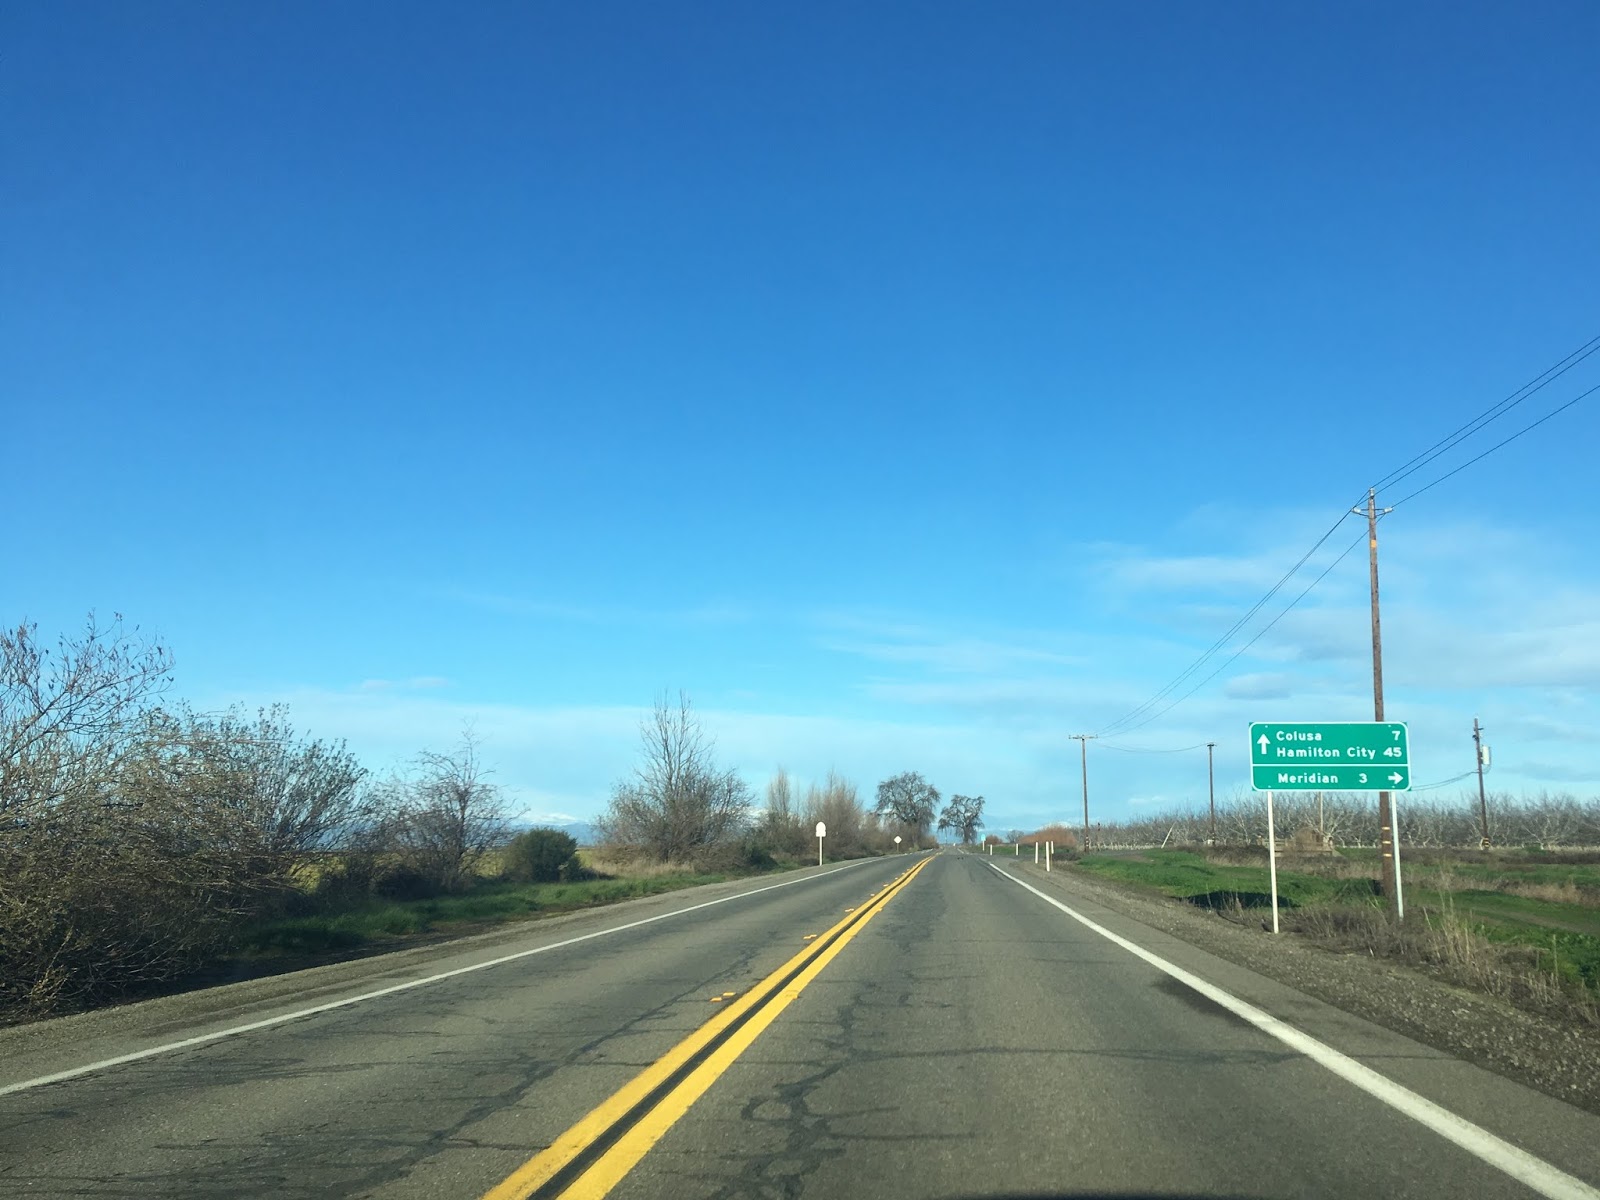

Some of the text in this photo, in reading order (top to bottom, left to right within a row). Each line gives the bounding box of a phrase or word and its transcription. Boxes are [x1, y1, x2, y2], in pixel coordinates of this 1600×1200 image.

[1276, 730, 1401, 741] Colusa 7
[1276, 747, 1402, 760] Hamilton City 45
[1277, 773, 1368, 784] Meridian 3
